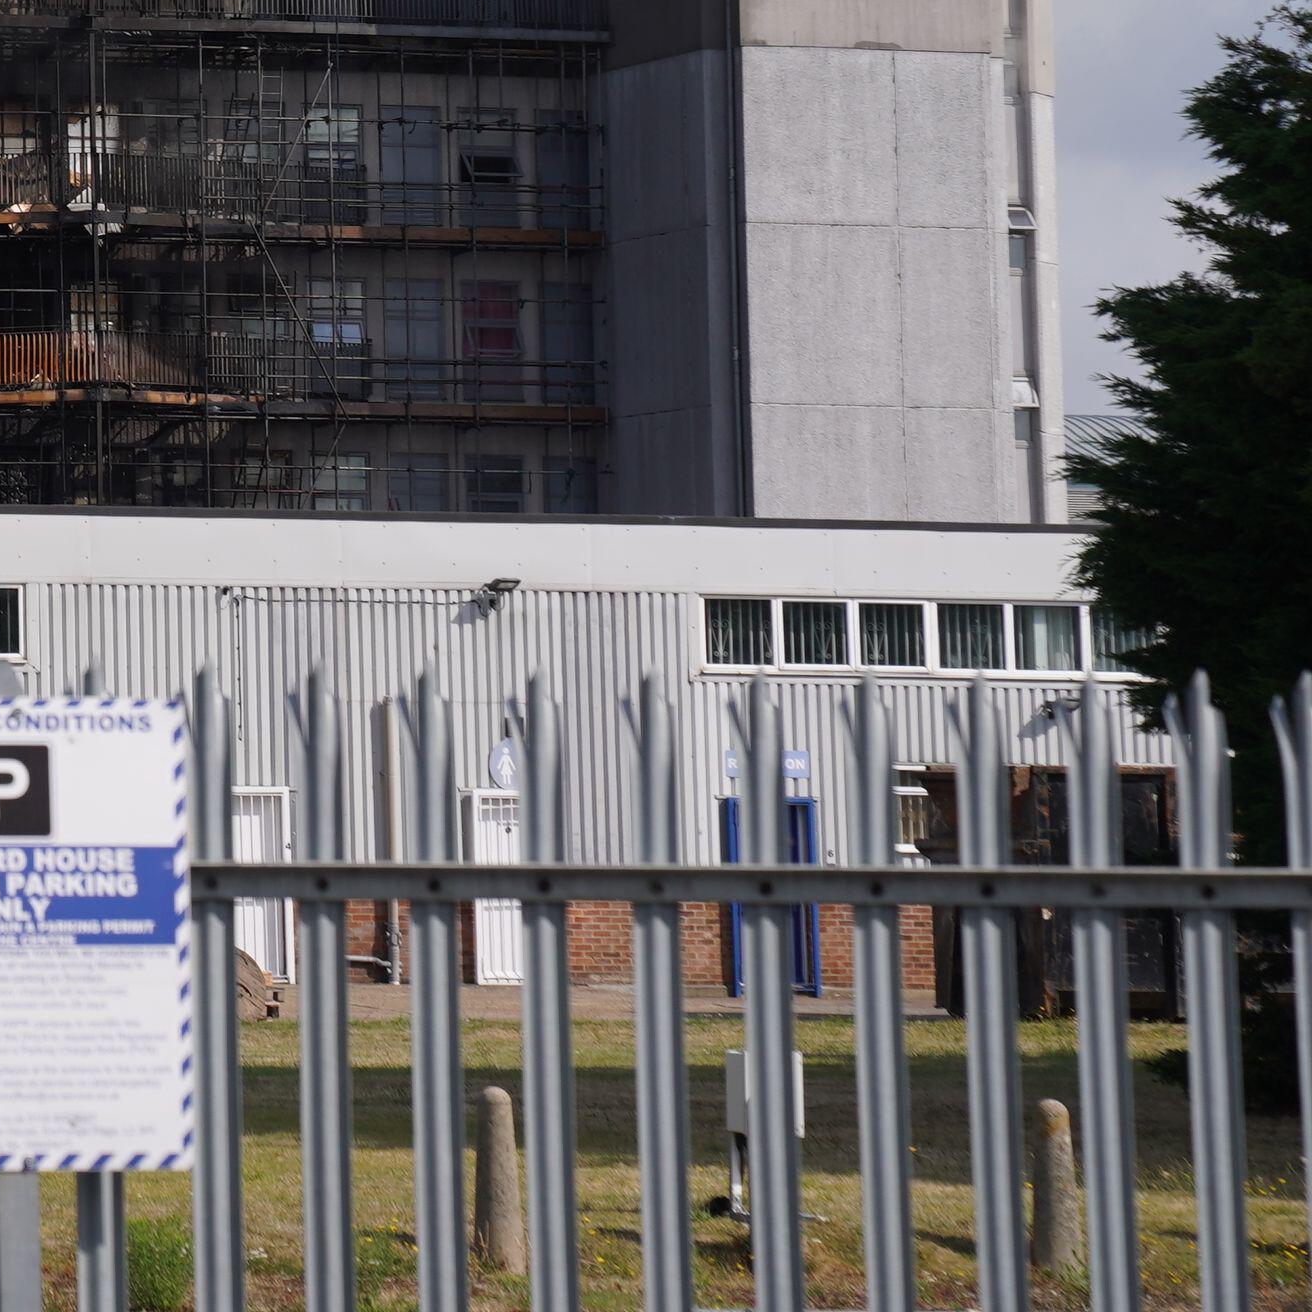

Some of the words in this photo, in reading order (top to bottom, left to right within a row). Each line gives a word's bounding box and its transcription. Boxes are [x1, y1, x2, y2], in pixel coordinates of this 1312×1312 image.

[33, 847, 136, 874] HOUSE
[6, 871, 139, 898] PARKING
[101, 918, 156, 935] PERMIT
